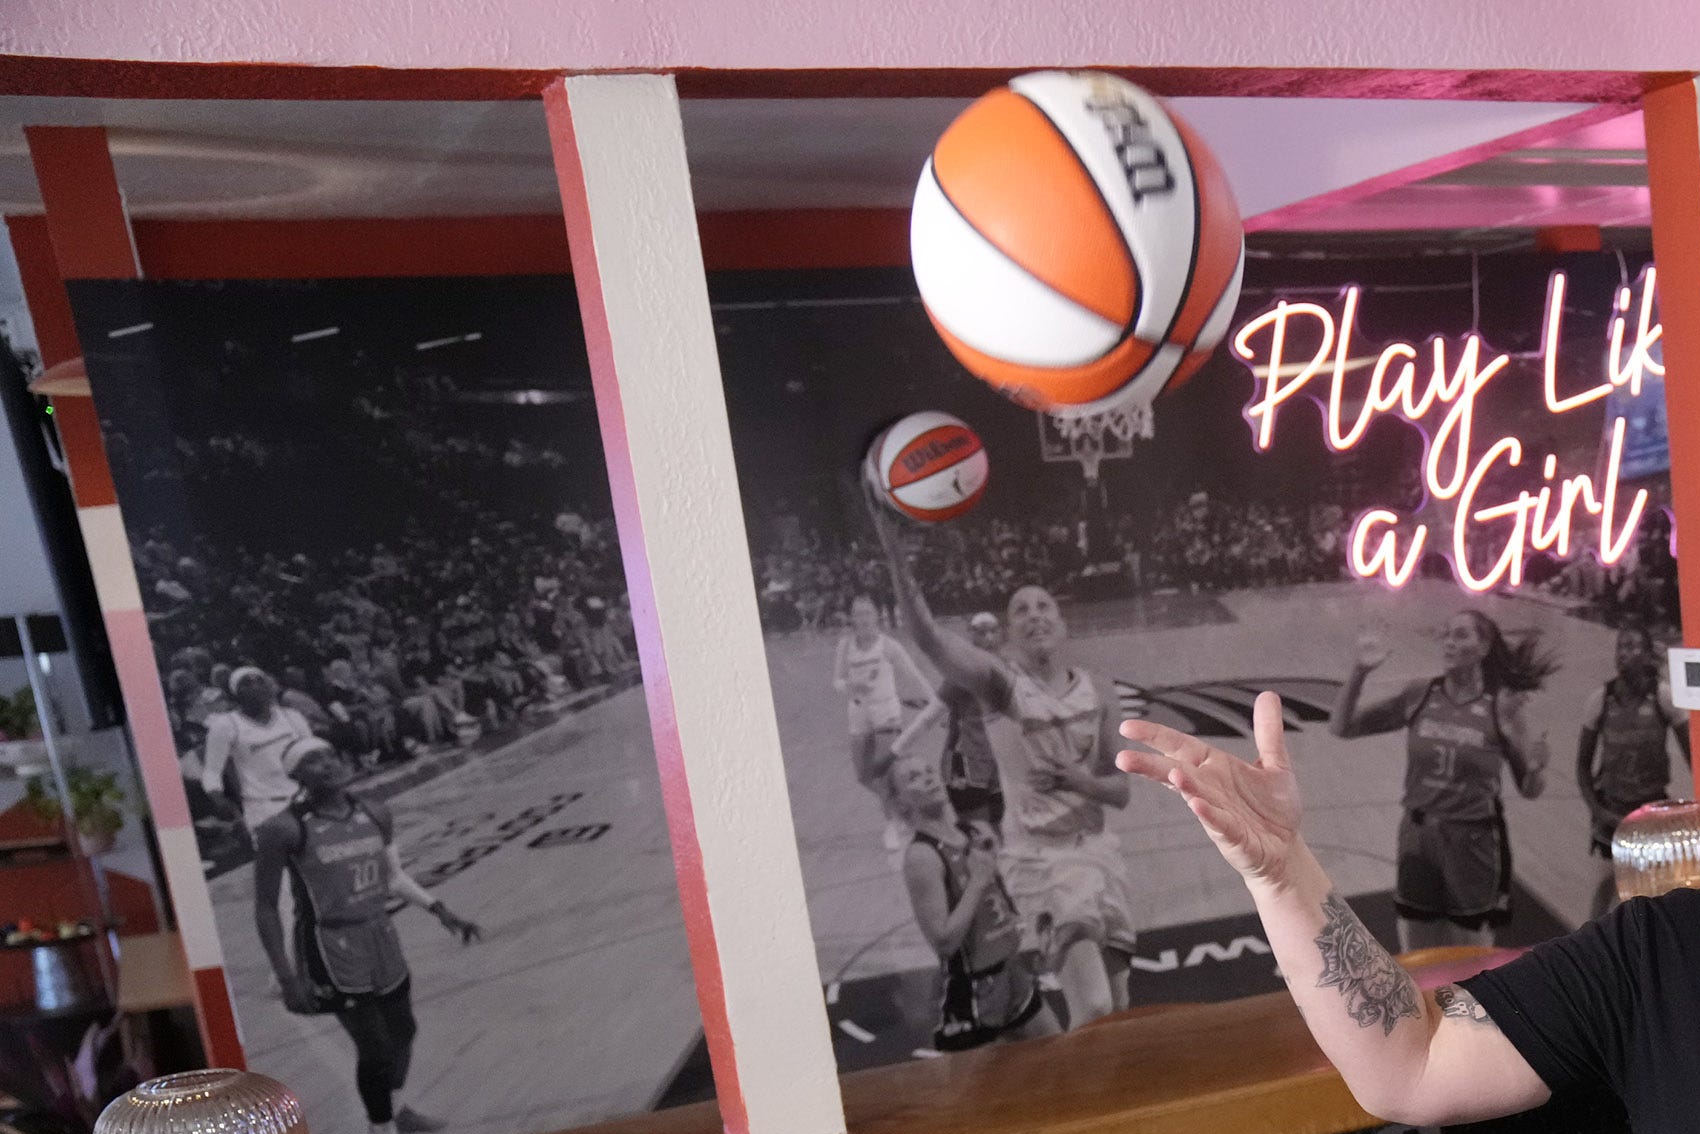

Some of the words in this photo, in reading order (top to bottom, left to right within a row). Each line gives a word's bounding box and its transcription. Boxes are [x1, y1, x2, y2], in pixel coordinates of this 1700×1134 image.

[1233, 285, 1511, 500] Play
[1543, 264, 1666, 416] Lik
[1351, 507, 1427, 591] a
[1453, 414, 1650, 593] Girl
